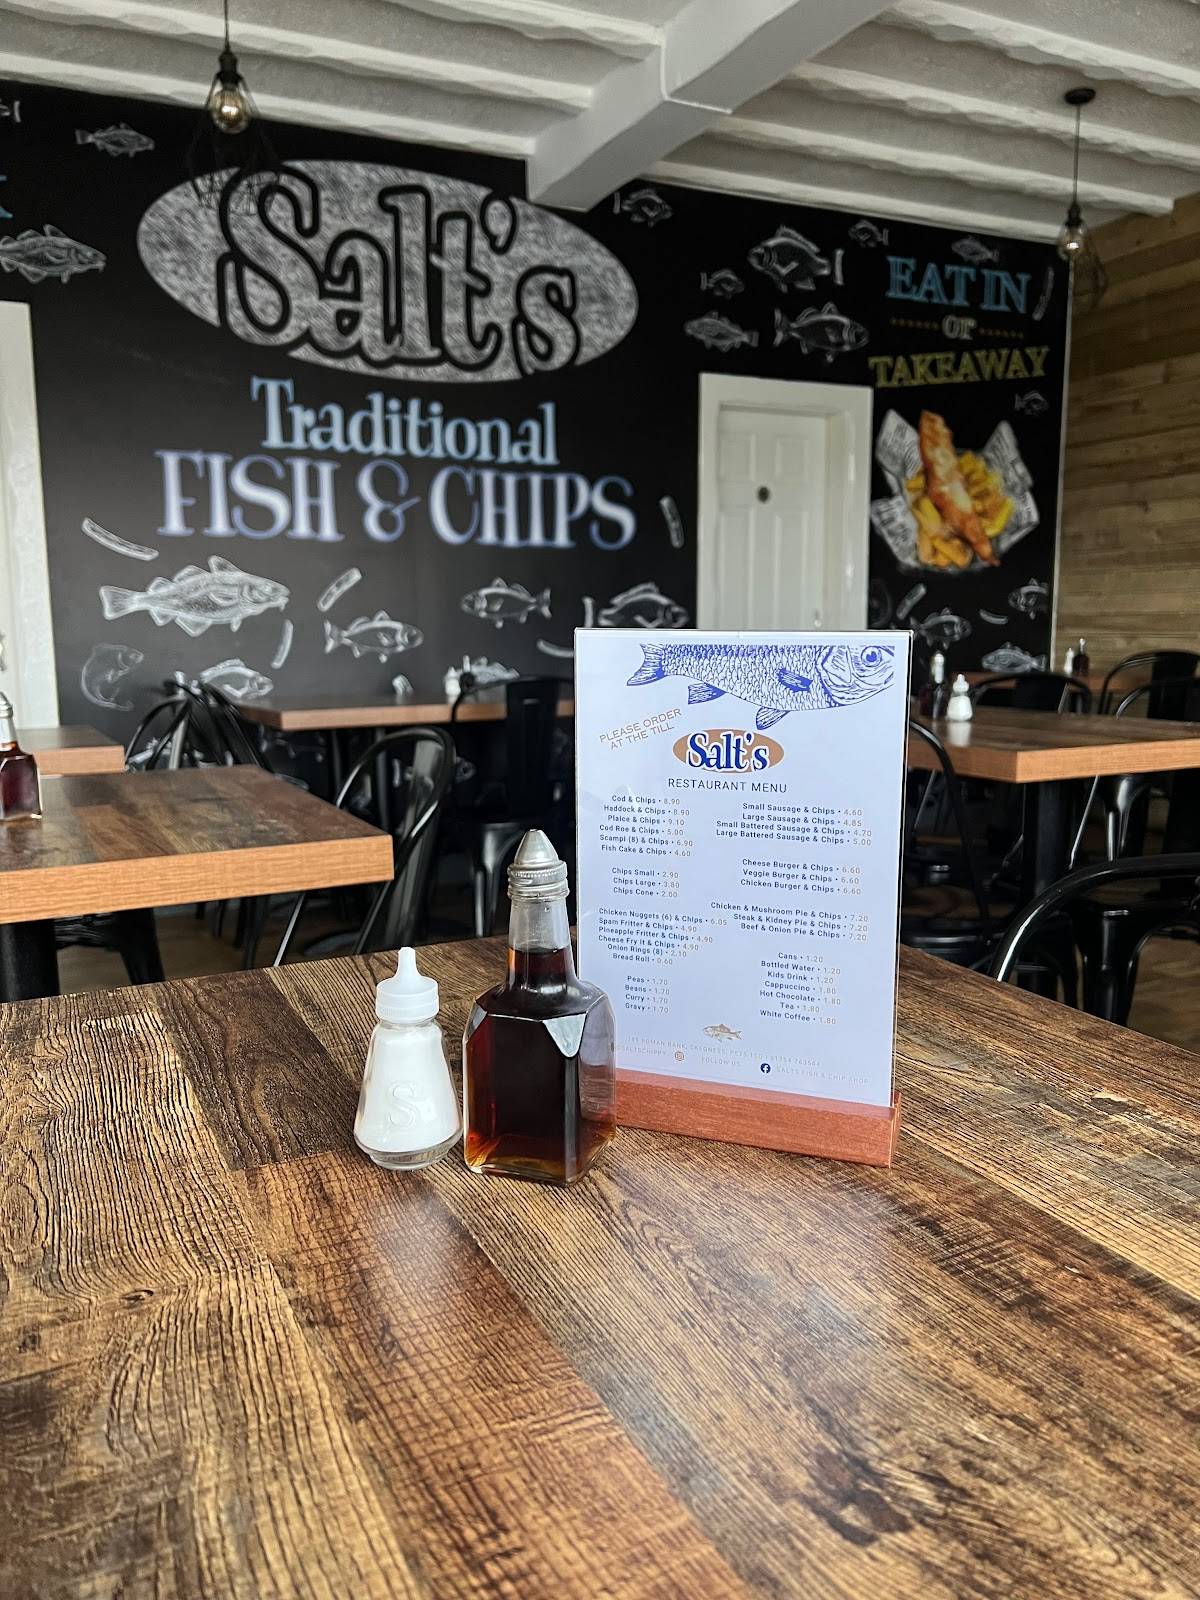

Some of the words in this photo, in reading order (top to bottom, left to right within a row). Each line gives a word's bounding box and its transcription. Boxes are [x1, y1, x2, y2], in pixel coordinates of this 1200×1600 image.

[219, 167, 578, 375] Salt's
[885, 256, 976, 307] EAT
[980, 269, 1031, 313] IN
[868, 346, 1049, 387] TAKEAWAY
[250, 375, 559, 465] Traditional
[155, 450, 345, 541] FISH
[357, 459, 420, 541] &
[429, 465, 636, 550] CHIPS
[599, 722, 641, 743] PLEASE
[643, 708, 682, 727] ORDER
[611, 738, 623, 750] AT
[625, 730, 649, 743] THE
[650, 723, 675, 735] TILL
[688, 733, 769, 771] Salt's
[668, 778, 746, 791] RESTAURANT
[751, 782, 787, 793] MENU
[611, 795, 626, 803] Cod
[635, 796, 656, 806] Chips
[603, 804, 635, 813] Haddock
[637, 806, 642, 814] &
[644, 807, 665, 816] Chips
[742, 802, 765, 811] Small
[767, 804, 801, 814] Sausage
[811, 806, 834, 816] Chips
[607, 814, 630, 823] Plaice
[639, 816, 660, 826] Chips
[742, 813, 764, 822] Large
[766, 814, 802, 824] Sausage
[811, 817, 835, 826] Chips
[599, 824, 613, 832] Cod
[615, 825, 629, 833] Roe
[631, 826, 636, 834] &
[638, 827, 659, 836] Chips
[716, 820, 738, 829] Small
[740, 822, 774, 831] Battered
[776, 824, 810, 834] Sausage
[812, 826, 818, 834] &
[821, 827, 844, 836] Chips
[599, 834, 626, 844] Scampi
[628, 835, 639, 844] (8)
[648, 837, 670, 847] Chips
[716, 829, 738, 839] Large
[740, 830, 774, 840] Battered
[776, 833, 810, 843] Sausage
[820, 836, 844, 845] Chips
[601, 844, 616, 852] Fish
[618, 845, 636, 853] Cake
[645, 847, 666, 857] Chips
[612, 867, 632, 877] Chips
[634, 869, 655, 877] Small
[742, 859, 771, 868] Cheese
[772, 861, 799, 871] Burger
[810, 864, 833, 874] Chips
[742, 868, 770, 878] Veggie
[772, 871, 799, 881] Burger
[809, 874, 832, 883] Chips
[612, 877, 633, 886] Chips
[635, 878, 656, 888] Large
[740, 878, 772, 888] Chicken
[774, 881, 801, 891] Burger
[811, 884, 834, 894] Chips
[613, 887, 633, 896] Chips
[635, 888, 654, 896] Cone
[598, 907, 627, 917] Chicken
[629, 910, 659, 920] Nuggets
[661, 912, 672, 922] (6)
[681, 914, 702, 924] Chips
[710, 902, 741, 911] Chicken
[743, 904, 748, 912] &
[751, 905, 792, 916] Mushroom
[795, 909, 808, 917] Pie
[810, 910, 816, 918] &
[818, 911, 841, 921] Chips
[598, 917, 618, 927] Spam
[620, 919, 644, 928] Fritter
[645, 921, 650, 929] &
[652, 922, 674, 932] Chips
[733, 913, 755, 922] Steak
[757, 915, 763, 923] &
[765, 916, 792, 927] Kidney
[794, 919, 808, 927] Pie
[809, 920, 817, 928] &
[817, 921, 840, 931] Chips
[598, 926, 634, 937] Pineapple
[634, 929, 659, 938] Fritter
[668, 932, 689, 942] Chips
[740, 923, 758, 931] Beef
[760, 924, 766, 932] &
[768, 925, 791, 934] Onion
[794, 928, 806, 936] Pie
[817, 930, 840, 940] Chips
[598, 934, 624, 944] Cheese
[626, 937, 637, 946] Fry
[654, 940, 675, 950] Chips
[607, 943, 628, 952] Onion
[628, 945, 650, 955] Rings
[652, 947, 663, 956] (8)
[612, 953, 633, 962] Bread
[635, 955, 650, 963] Roll
[778, 952, 797, 961] Cans
[760, 960, 789, 970] Bottled
[792, 963, 815, 972] Water
[627, 974, 644, 983] Peas
[767, 971, 784, 979] Kids
[787, 972, 808, 981] Drink
[624, 984, 646, 993] Beans
[764, 980, 810, 992] Cappuccino
[625, 993, 644, 1004] Curry
[760, 990, 773, 998] Hot
[775, 991, 815, 1002] Chocolate
[625, 1002, 645, 1013] Gravy
[780, 1001, 794, 1010] Tea
[760, 1009, 782, 1019] White
[784, 1012, 810, 1022] Coffee
[387, 1081, 421, 1129] S
